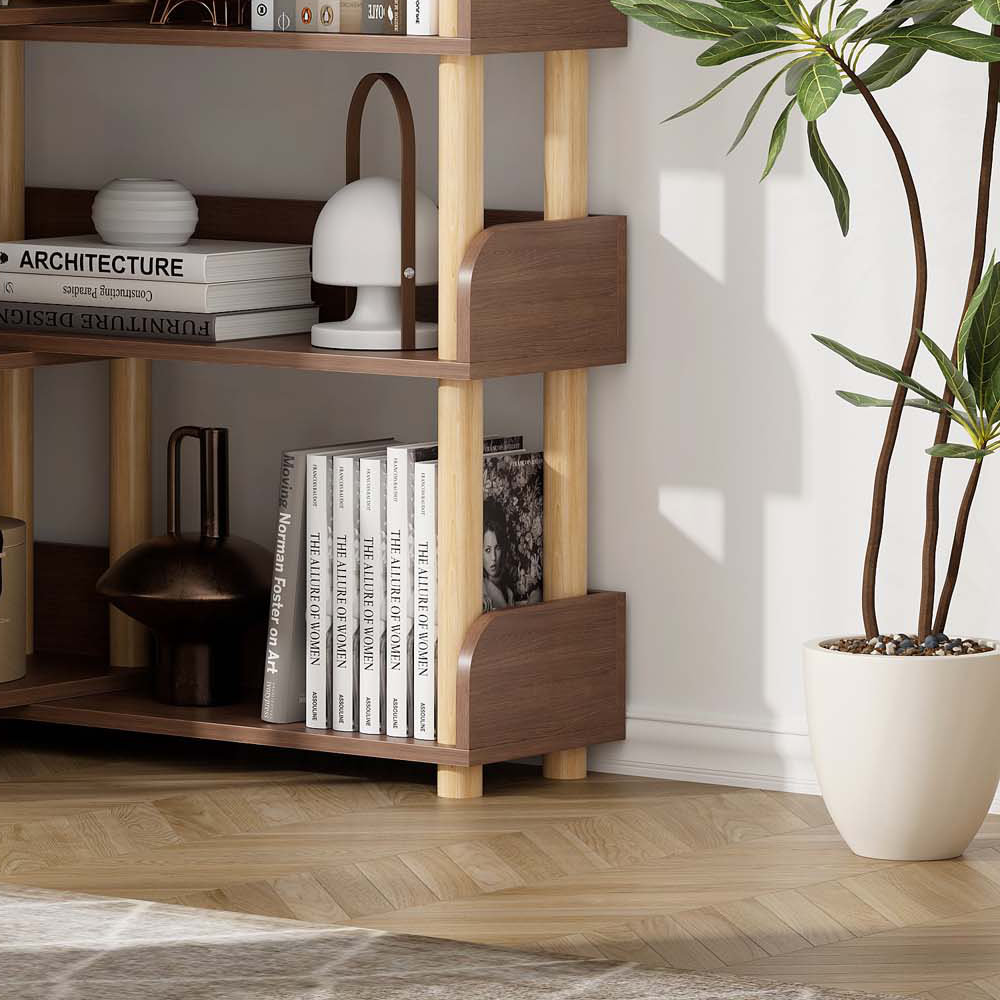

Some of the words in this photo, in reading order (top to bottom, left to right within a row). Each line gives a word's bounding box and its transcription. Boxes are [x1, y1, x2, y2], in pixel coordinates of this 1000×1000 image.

[20, 250, 184, 278] ARCHITECTURE
[100, 285, 153, 302] Constructing
[81, 312, 210, 337] FURNITURE
[281, 454, 295, 510] Moving
[275, 512, 291, 573] Norman
[310, 532, 320, 556] THE
[336, 535, 347, 557] THE
[363, 536, 374, 560] THE
[390, 530, 401, 555] THE
[417, 541, 429, 565] THE
[310, 558, 320, 602] ALLURE
[336, 559, 347, 605] ALLURE
[363, 562, 374, 607] ALLURE
[390, 557, 401, 603] ALLURE
[417, 566, 429, 612] ALLURE
[272, 577, 286, 623] Foster
[310, 604, 320, 620] OF
[336, 607, 347, 623] OF
[363, 609, 374, 625] OF
[390, 605, 401, 622] OF
[417, 614, 429, 629] OF
[269, 628, 279, 646] on
[310, 622, 320, 666] WOMEN
[336, 625, 347, 669] WOMEN
[363, 626, 374, 671] WOMEN
[390, 624, 401, 671] WOMEN
[266, 650, 279, 674] Art
[417, 631, 429, 676] WOMEN
